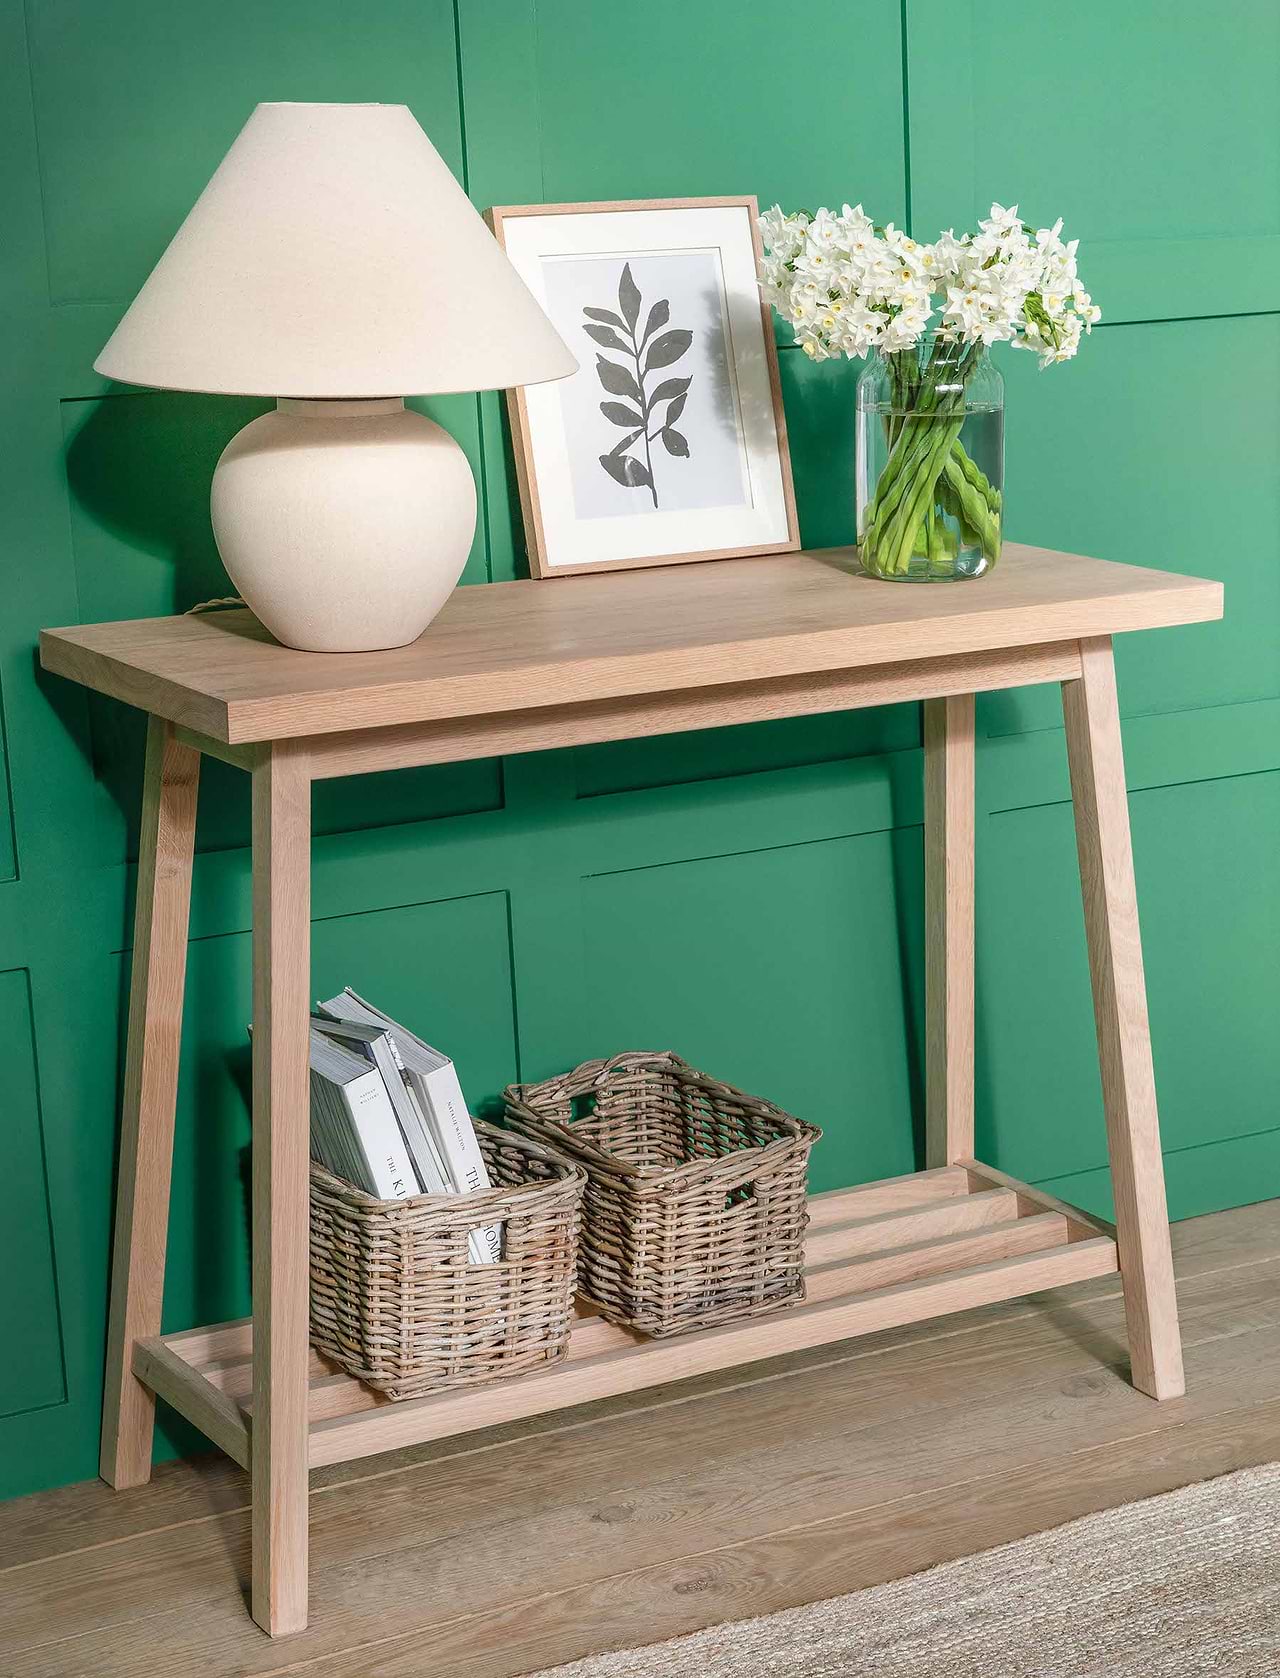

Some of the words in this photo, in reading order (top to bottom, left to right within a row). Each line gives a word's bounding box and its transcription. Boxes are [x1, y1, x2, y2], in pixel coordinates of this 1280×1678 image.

[455, 1126, 466, 1151] WALTON
[386, 1155, 397, 1173] THE
[392, 1179, 408, 1200] KI
